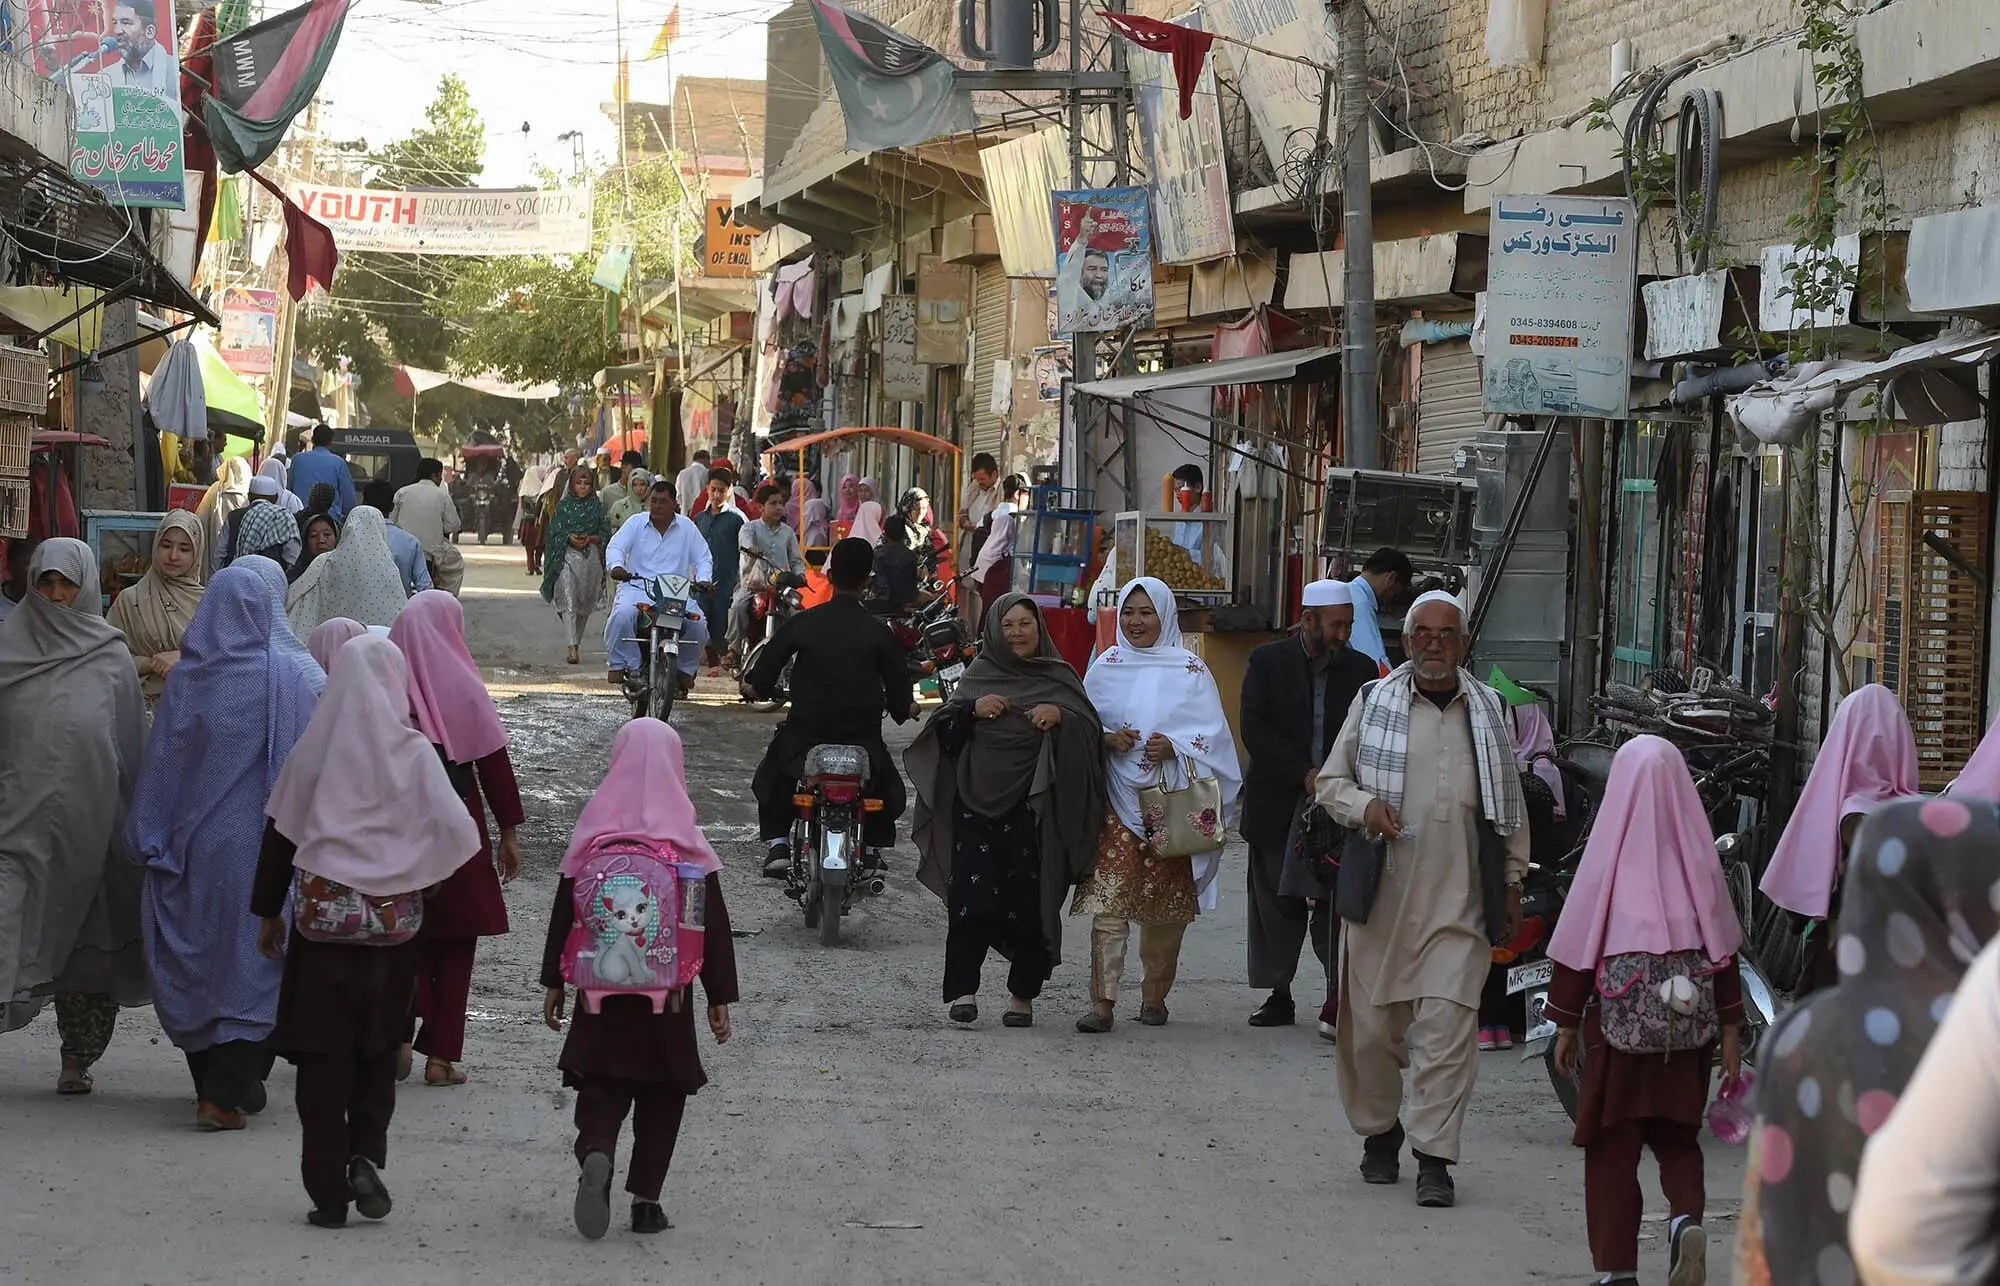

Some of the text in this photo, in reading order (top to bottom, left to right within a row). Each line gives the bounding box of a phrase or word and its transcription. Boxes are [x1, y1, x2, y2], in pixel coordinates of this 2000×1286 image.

[232, 39, 257, 88] MWM
[884, 39, 902, 69] WM
[83, 140, 126, 177] خان
[149, 141, 178, 173] محمد
[299, 189, 574, 225] YOUTH EDUCATIONAL SOCIETY
[1498, 200, 1624, 228] علی رضا
[1502, 230, 1550, 255] ورکس
[711, 252, 724, 265] OF
[1510, 317, 1578, 329] 0345-8394608
[1510, 335, 1578, 347] 0343-2085714
[344, 434, 391, 444] SAZGAR
[1508, 972, 1525, 988] MK
